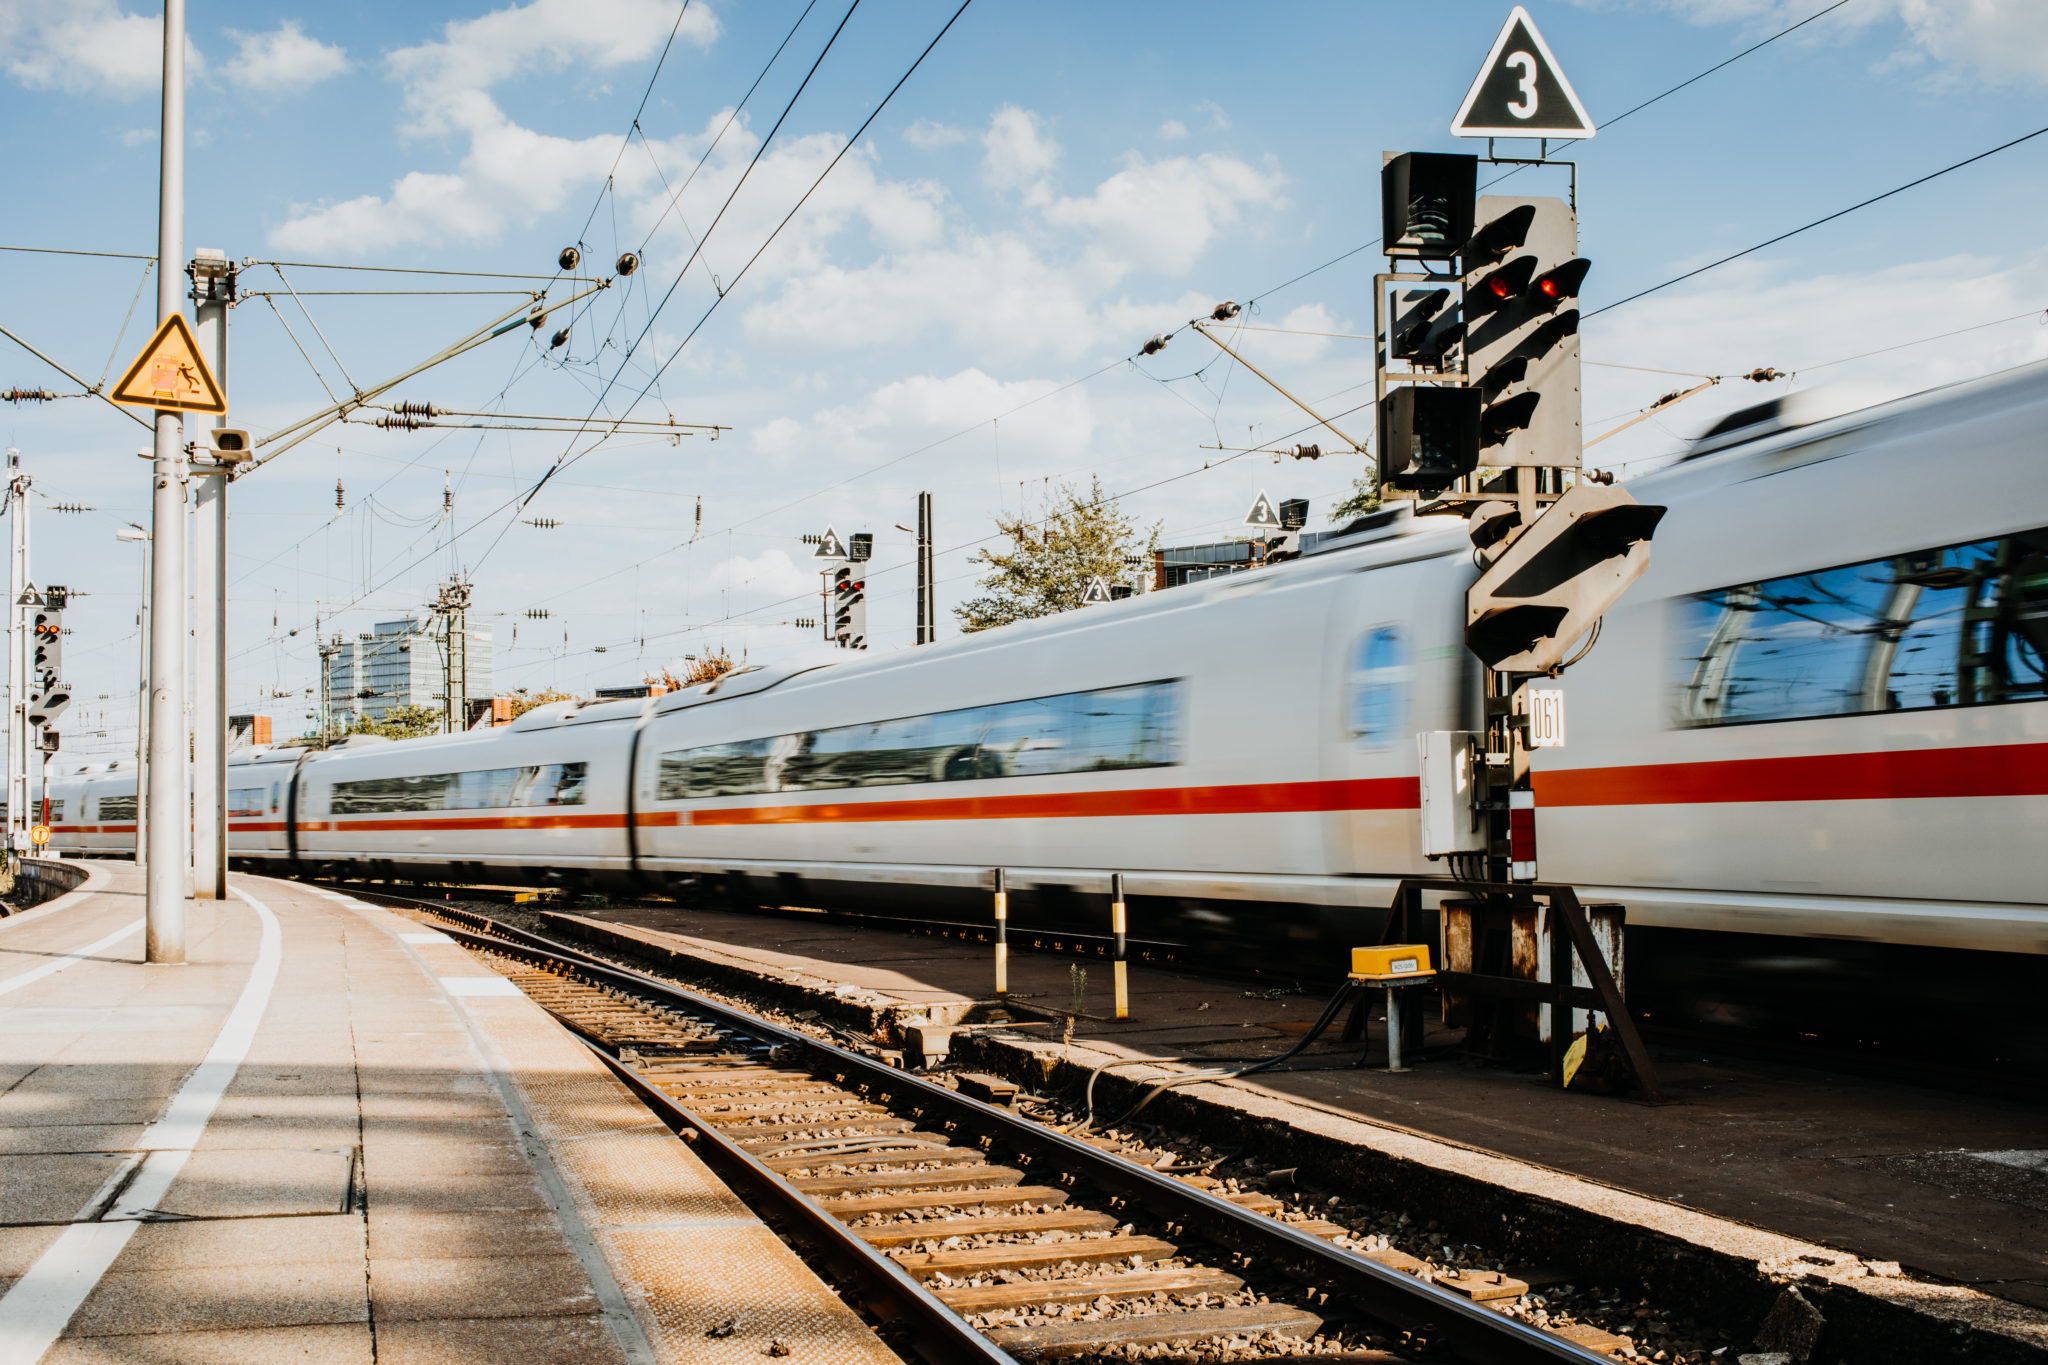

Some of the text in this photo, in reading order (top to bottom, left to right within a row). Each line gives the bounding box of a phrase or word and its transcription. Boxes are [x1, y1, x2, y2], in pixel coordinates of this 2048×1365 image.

[1505, 50, 1539, 120] 3
[1257, 500, 1268, 522] 3
[823, 534, 836, 555] 3
[26, 588, 36, 604] 3
[1093, 584, 1102, 601] 3
[1533, 697, 1560, 739] 061
